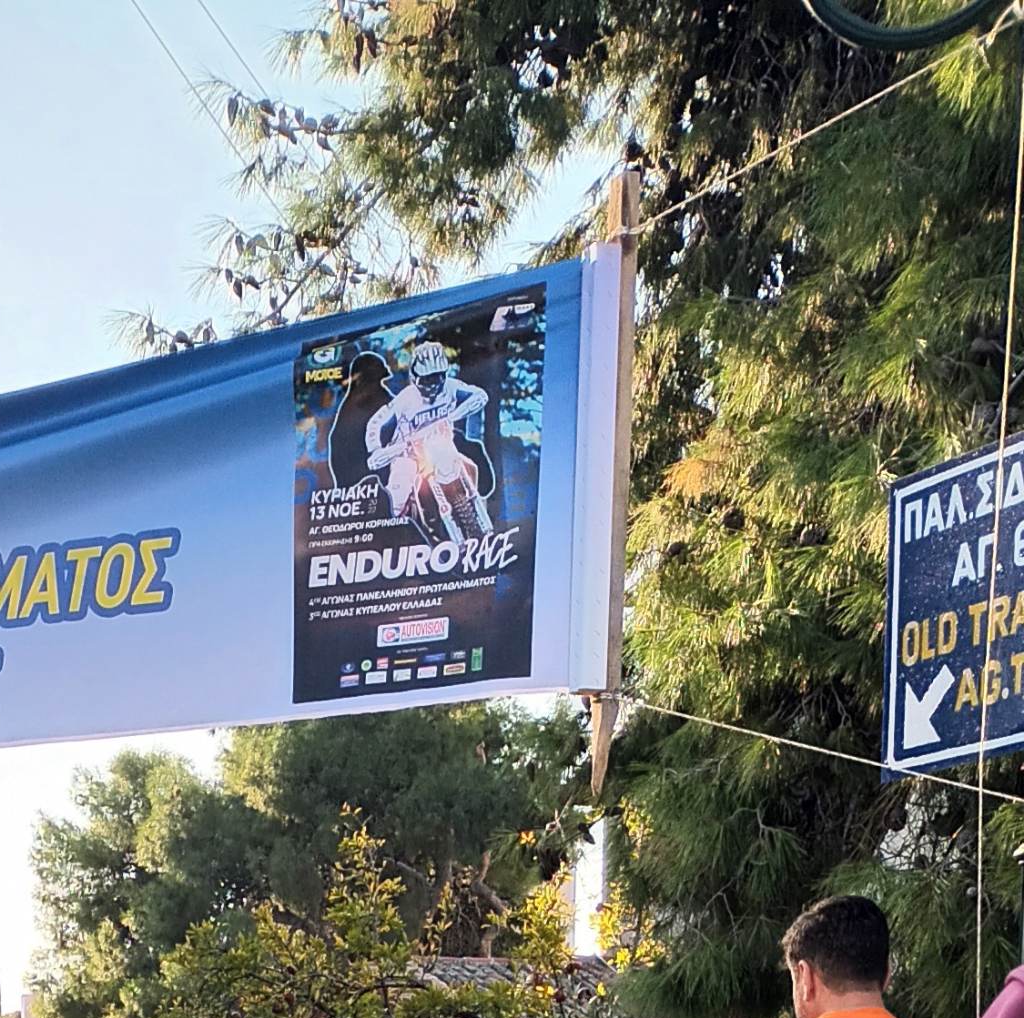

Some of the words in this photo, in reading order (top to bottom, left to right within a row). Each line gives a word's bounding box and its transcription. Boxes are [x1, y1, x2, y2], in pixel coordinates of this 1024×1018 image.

[310, 506, 325, 520] 13
[328, 502, 364, 518] ΝΟΕ.
[311, 484, 378, 505] ΚΥΡΙΑΚΗ
[308, 541, 459, 588] ENDURO
[462, 527, 519, 573] RACE
[902, 611, 958, 667] OLD
